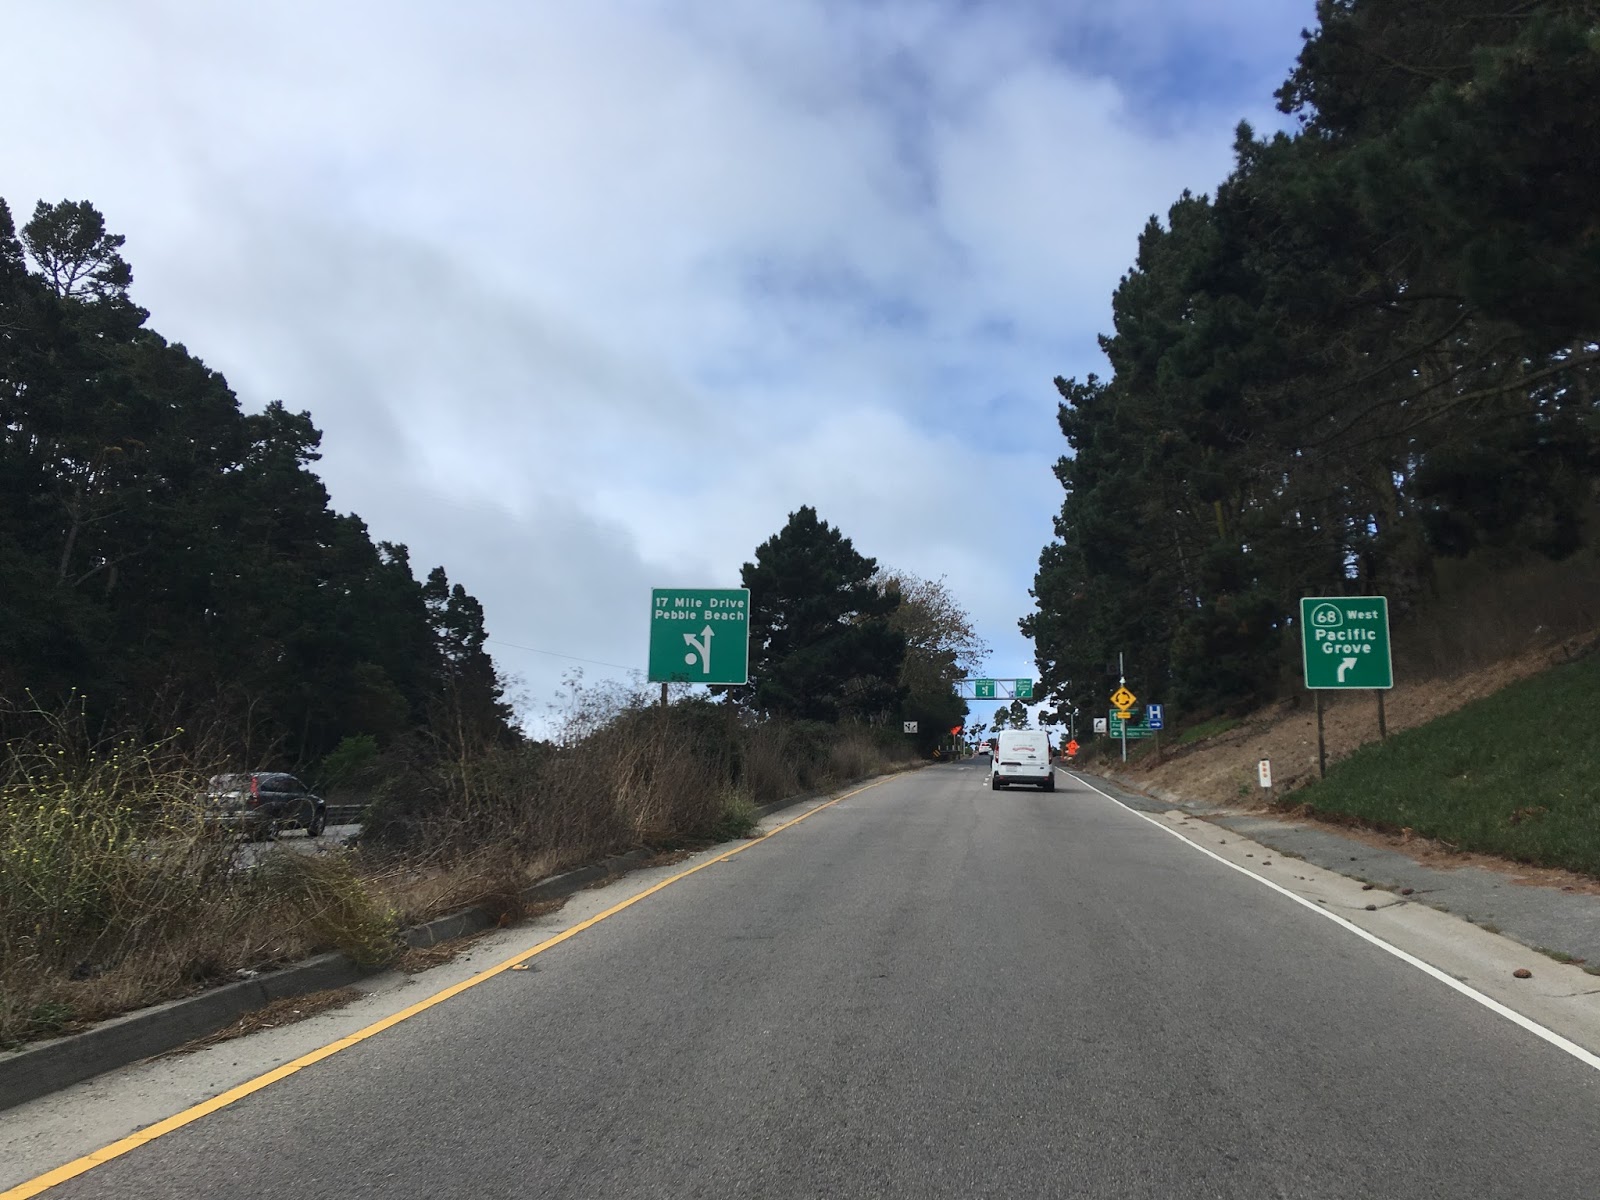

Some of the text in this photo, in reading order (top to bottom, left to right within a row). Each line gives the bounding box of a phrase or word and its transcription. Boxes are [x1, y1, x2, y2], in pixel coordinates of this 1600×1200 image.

[656, 597, 745, 608] 17 Mile Drive
[655, 609, 744, 620] Pebble Beach
[1317, 609, 1379, 623] 68 West
[1315, 628, 1376, 641] Pacific
[1322, 641, 1371, 654] Grove
[1149, 705, 1161, 719] H
